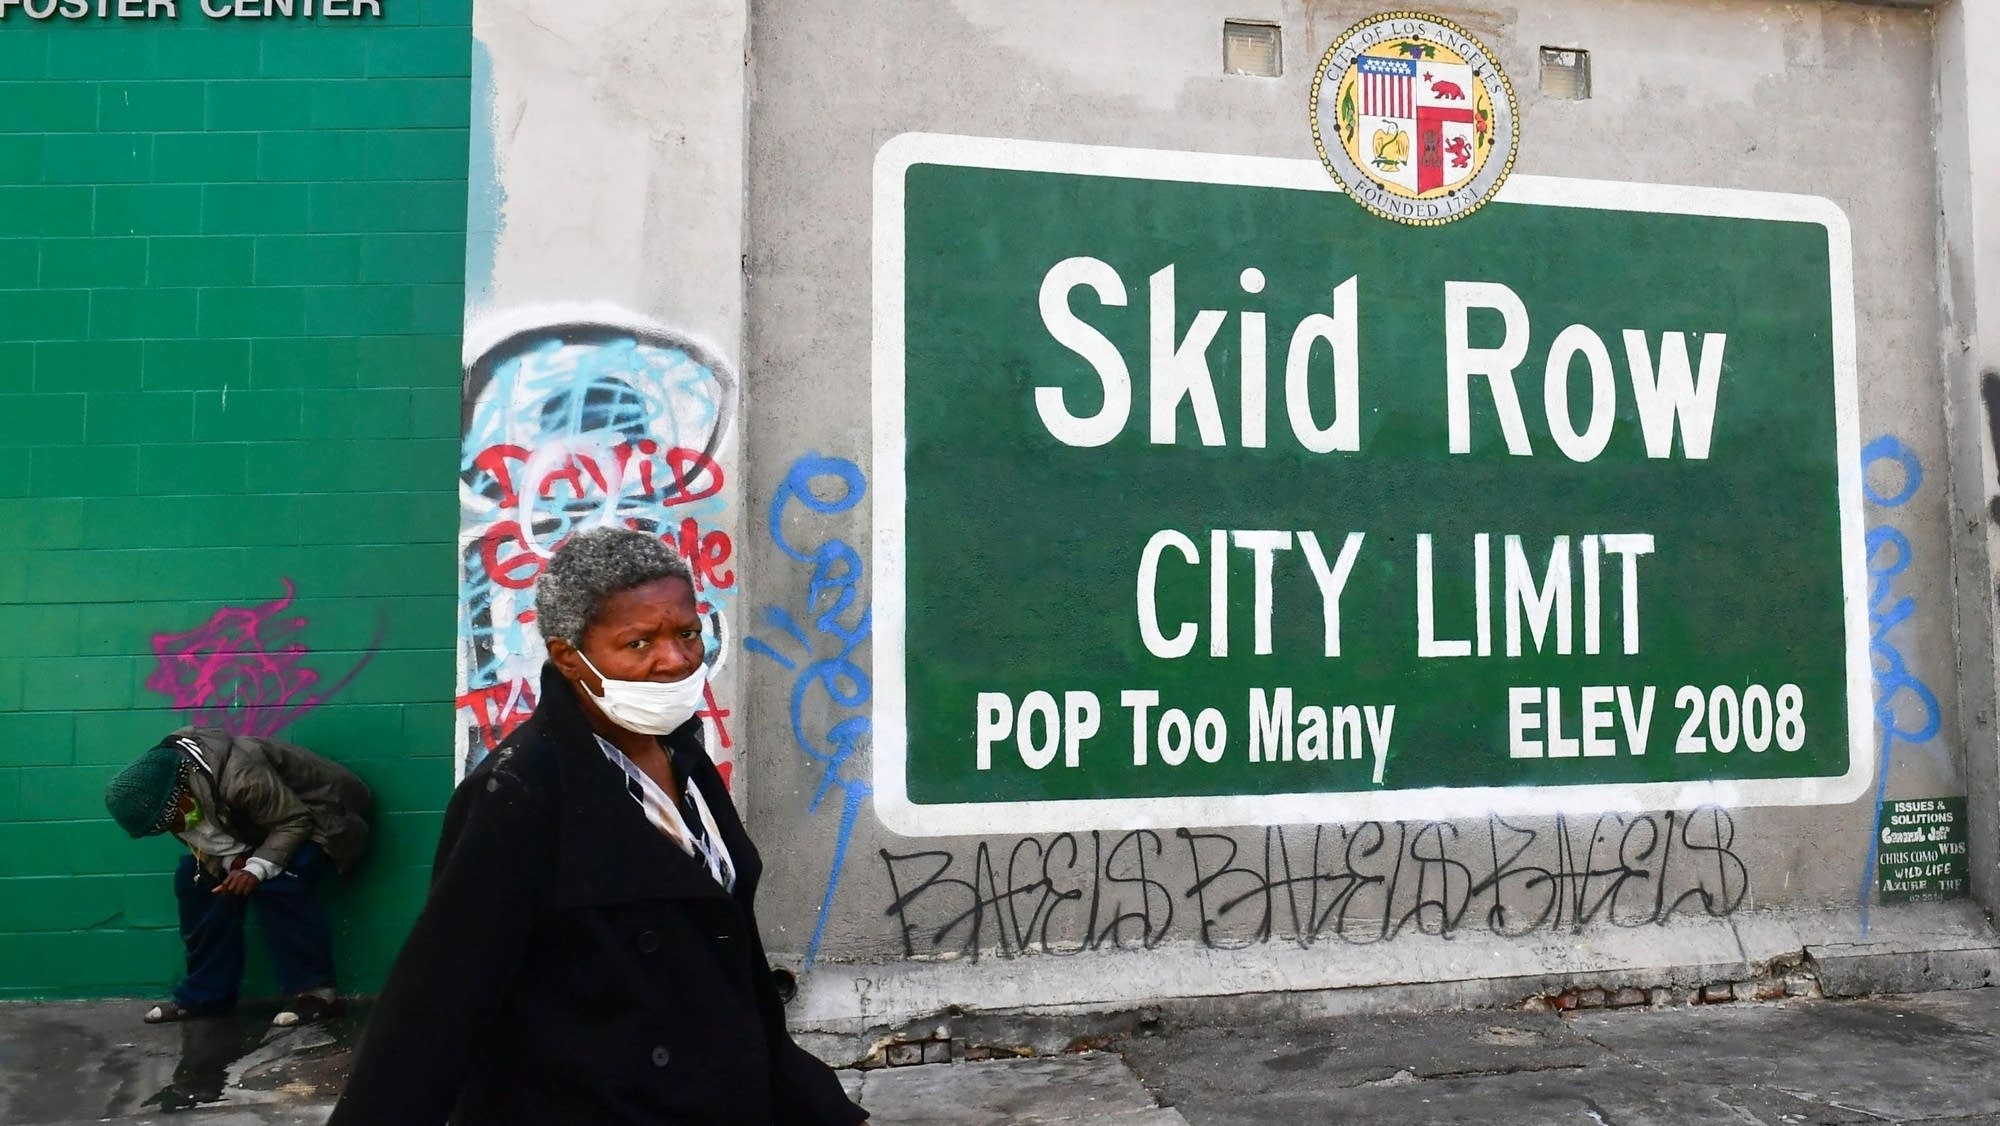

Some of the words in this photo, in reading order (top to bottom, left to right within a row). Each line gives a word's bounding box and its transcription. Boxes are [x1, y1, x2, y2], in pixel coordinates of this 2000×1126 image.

[1326, 43, 1358, 82] CITY
[1361, 26, 1387, 45] OF
[1391, 22, 1426, 36] LOS
[1434, 29, 1503, 95] ANGELES
[1353, 180, 1439, 218] FOUNDED
[1447, 187, 1479, 214] 1781
[1034, 256, 1360, 454] Skid
[1445, 280, 1727, 463] Row
[1136, 529, 1366, 659] CITY
[1416, 532, 1656, 658] LIMIT
[976, 689, 1101, 770] POP
[1120, 689, 1227, 766] Too
[1248, 687, 1396, 784] Many
[1508, 685, 1657, 759] ELEV
[1674, 683, 1807, 754] 2008
[1891, 812, 1954, 825] SOLUTIONS
[1895, 801, 1935, 813] ISSUES
[1937, 801, 1946, 810] &
[1880, 852, 1909, 864] CHRIS
[1910, 850, 1938, 863] COMO
[1938, 842, 1966, 855] WDS
[1895, 866, 1923, 879] WILD
[1925, 863, 1951, 876] LIFE
